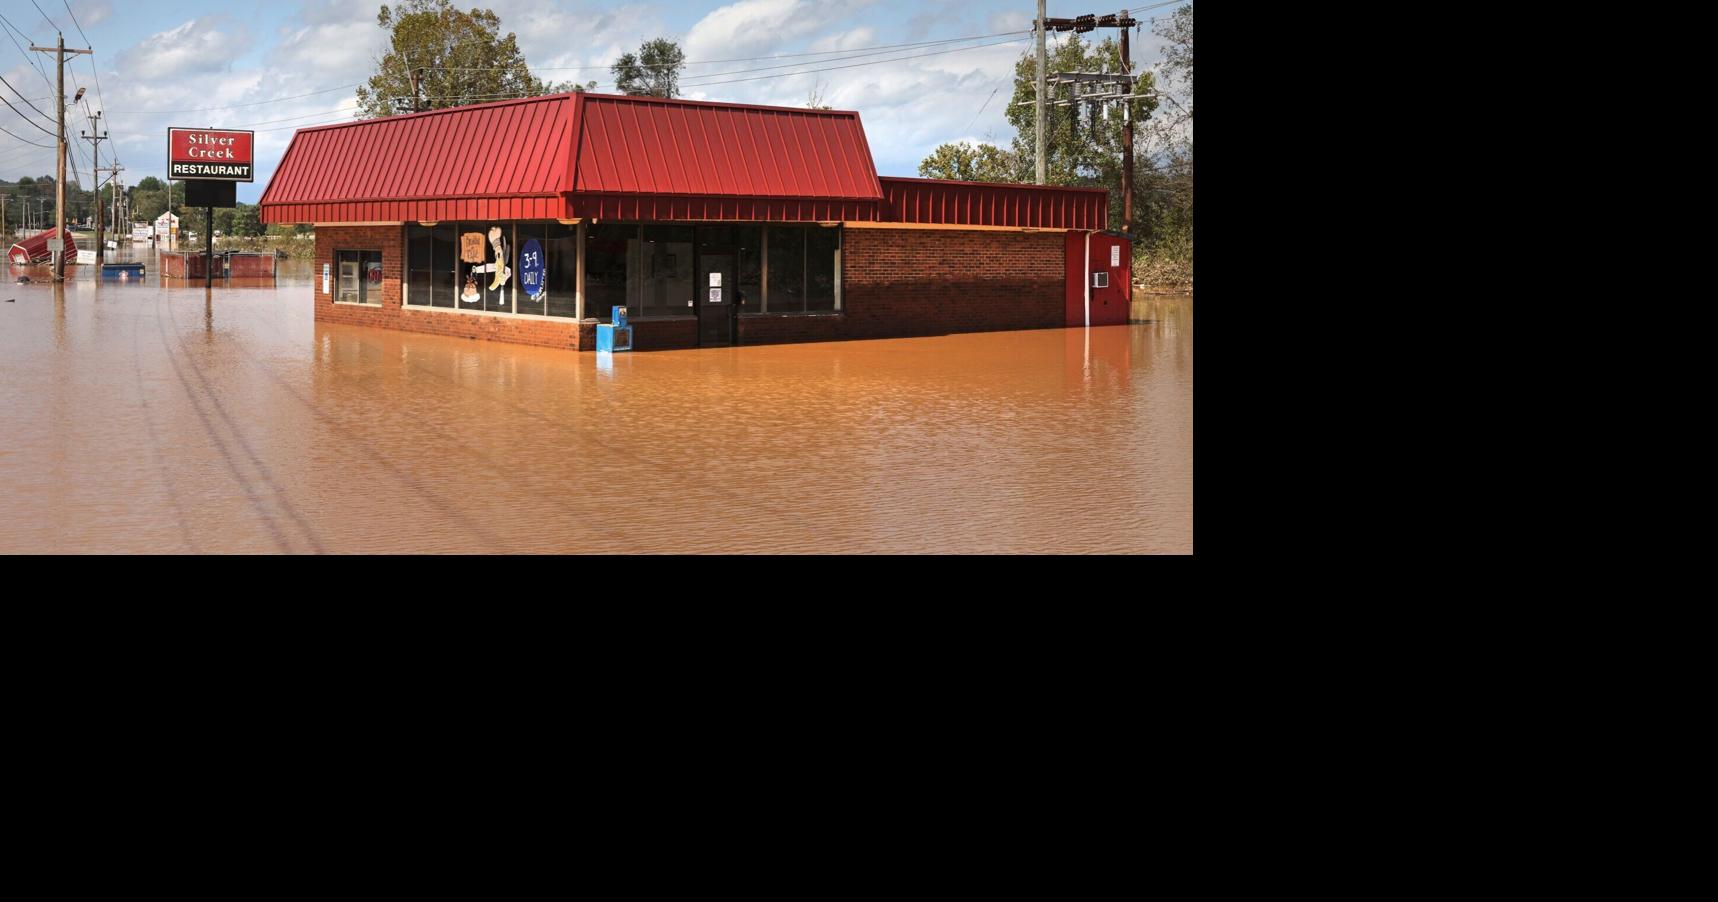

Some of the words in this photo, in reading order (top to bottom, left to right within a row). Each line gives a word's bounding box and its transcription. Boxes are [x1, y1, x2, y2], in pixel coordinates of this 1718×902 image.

[189, 134, 234, 145] Silver
[188, 147, 234, 158] Creek
[173, 164, 249, 175] RESTAURANT
[523, 271, 538, 285] DAILY
